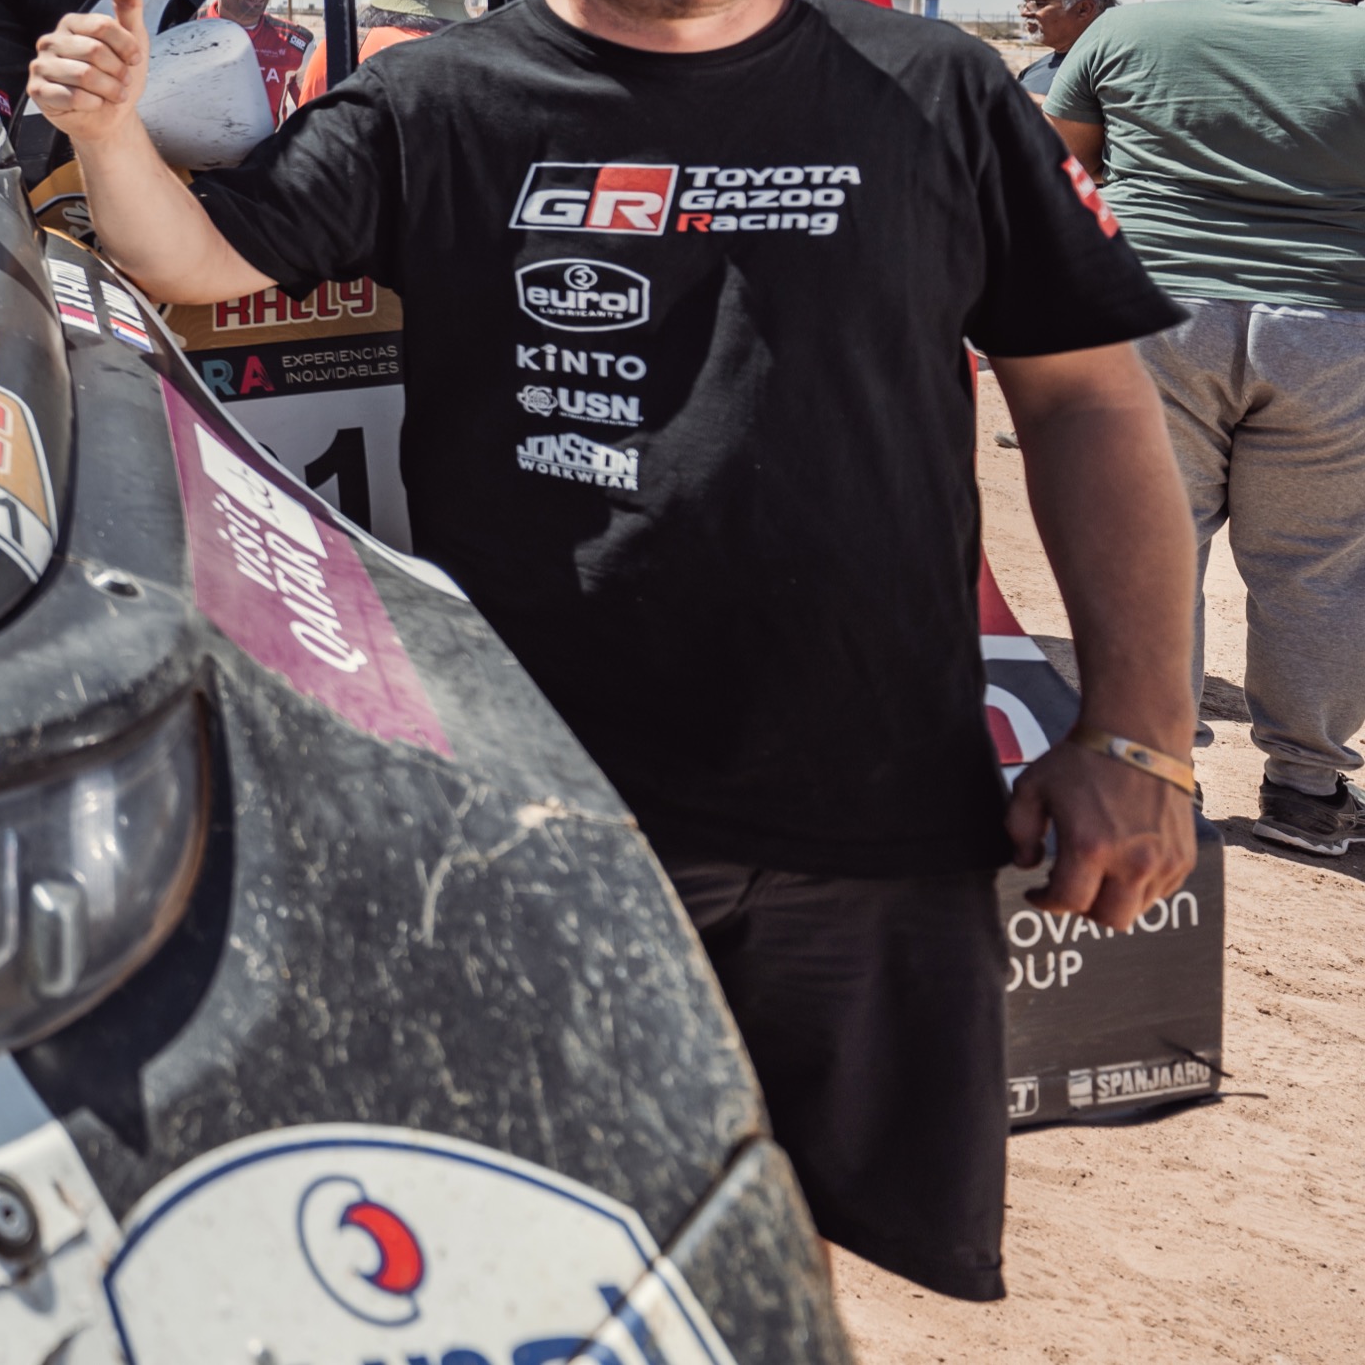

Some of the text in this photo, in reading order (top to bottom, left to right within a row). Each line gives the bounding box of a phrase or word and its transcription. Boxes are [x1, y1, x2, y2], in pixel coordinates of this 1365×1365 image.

[684, 165, 861, 188] TOYOTA
[520, 189, 664, 229] GR
[679, 189, 846, 210] GAZOO
[676, 211, 839, 235] Racing
[526, 286, 639, 315] eurol
[539, 306, 624, 319] LUBRICANTS
[282, 345, 398, 368] EXPERIENCIAS
[285, 361, 400, 384] INOLVIDABLES
[557, 387, 641, 421] USN
[516, 433, 639, 476] JONSSON
[517, 458, 639, 491] WORKWEAR
[212, 492, 278, 592] visit
[264, 531, 368, 673] QATAR
[1096, 1060, 1212, 1098] SPANJAARD
